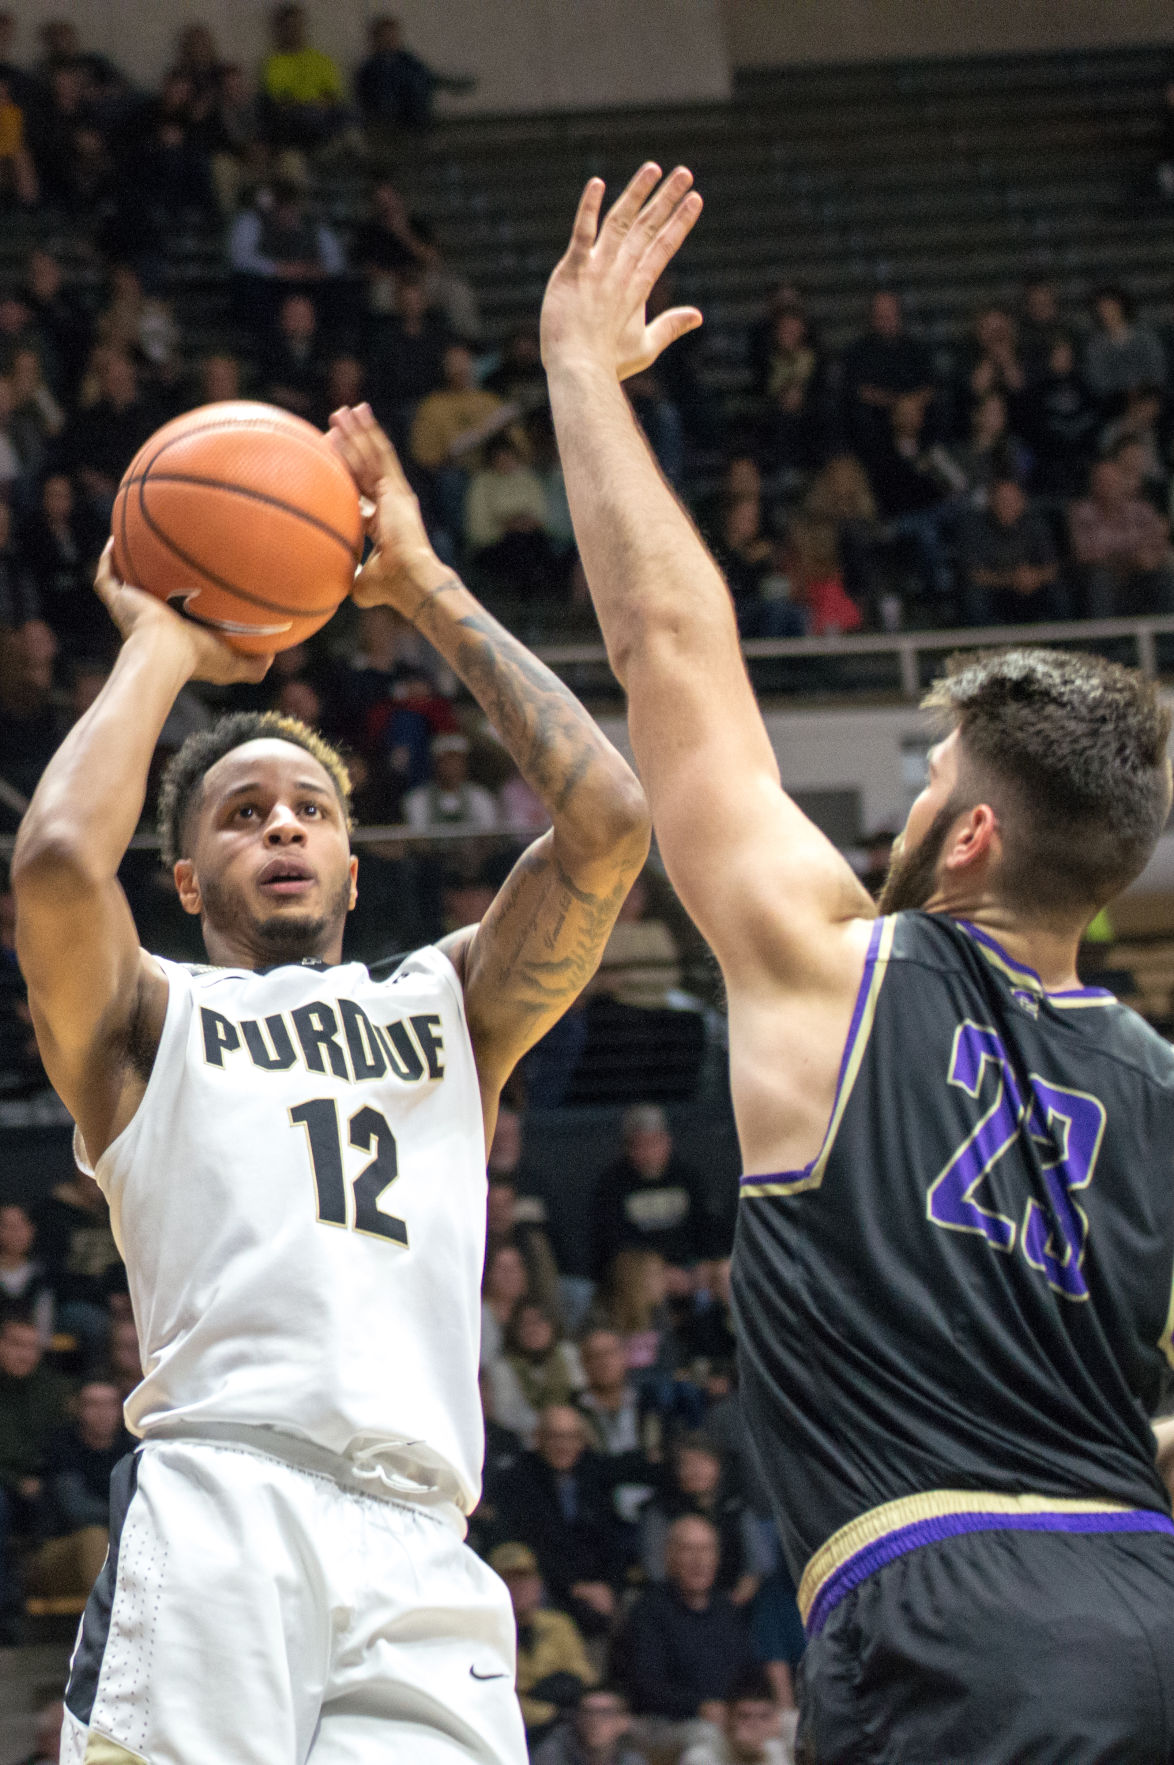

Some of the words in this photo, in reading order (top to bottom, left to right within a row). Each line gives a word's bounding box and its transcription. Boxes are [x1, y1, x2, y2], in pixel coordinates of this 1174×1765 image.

[199, 998, 446, 1085] PURDUE
[287, 1097, 410, 1250] 12
[926, 1018, 1107, 1301] 23
